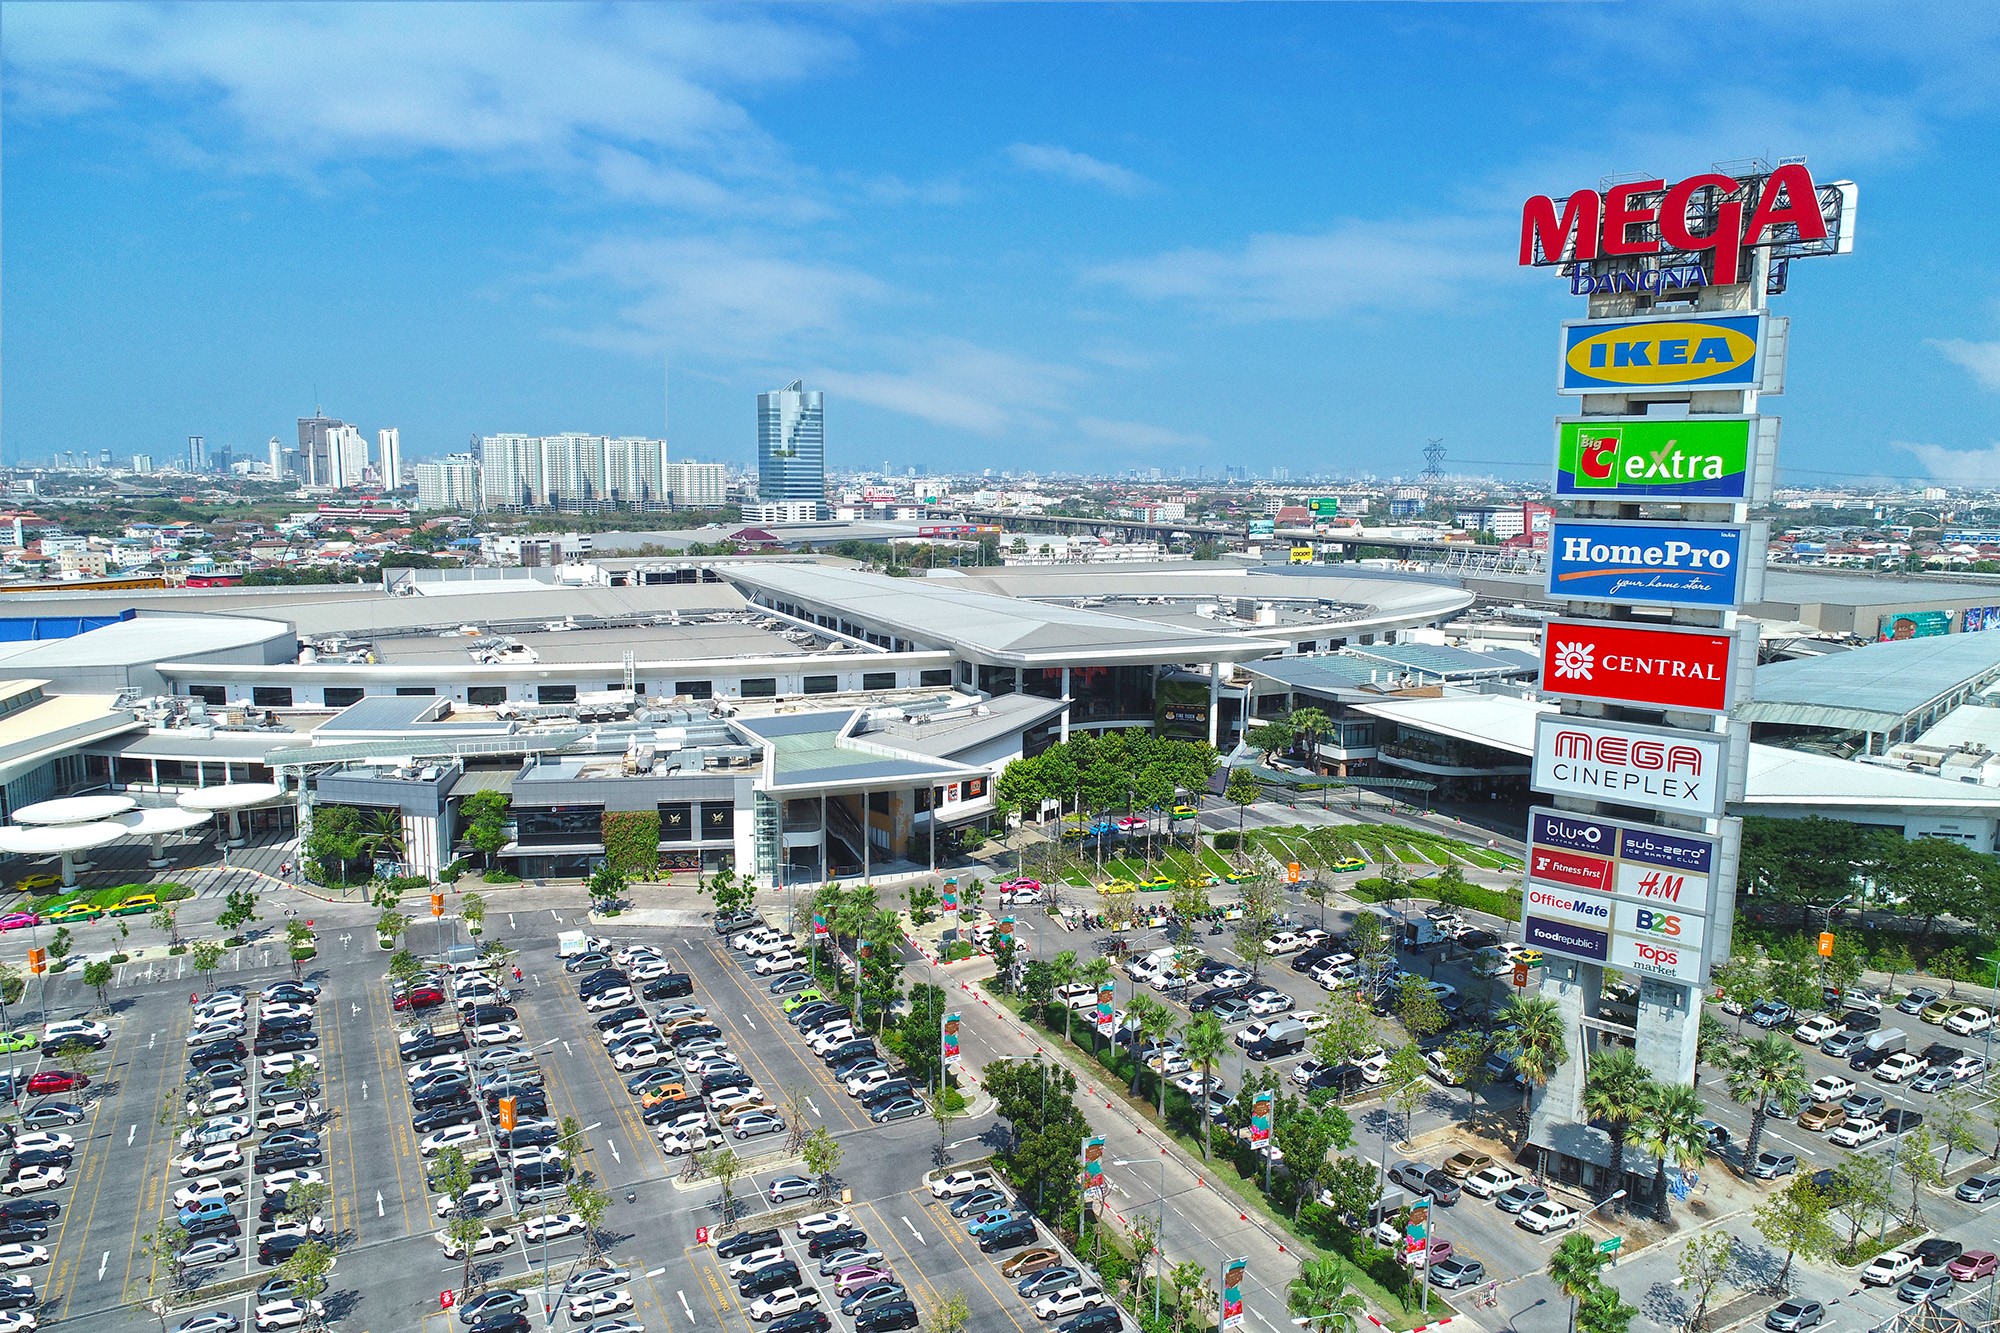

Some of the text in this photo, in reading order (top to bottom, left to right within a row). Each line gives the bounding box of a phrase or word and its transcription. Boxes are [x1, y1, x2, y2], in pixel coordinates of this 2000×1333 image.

[1589, 337, 1735, 368] IKEA
[1581, 437, 1602, 451] Big
[1581, 437, 1619, 479] C
[1562, 537, 1731, 568] HomePro
[1610, 575, 1712, 594] your home store
[1602, 655, 1721, 681] CENTRAL
[1555, 731, 1702, 776] MEGA
[1553, 764, 1700, 800] CINEPLEX
[1676, 857, 1700, 865] CLUB
[1290, 871, 1297, 879] G
[1637, 871, 1685, 903] H&M
[1529, 891, 1608, 917] OfficeMate
[1636, 909, 1681, 935] B2S
[1635, 943, 1677, 965] Tops
[1516, 973, 1525, 982] G
[1633, 961, 1677, 977] market
[502, 1113, 509, 1124] H
